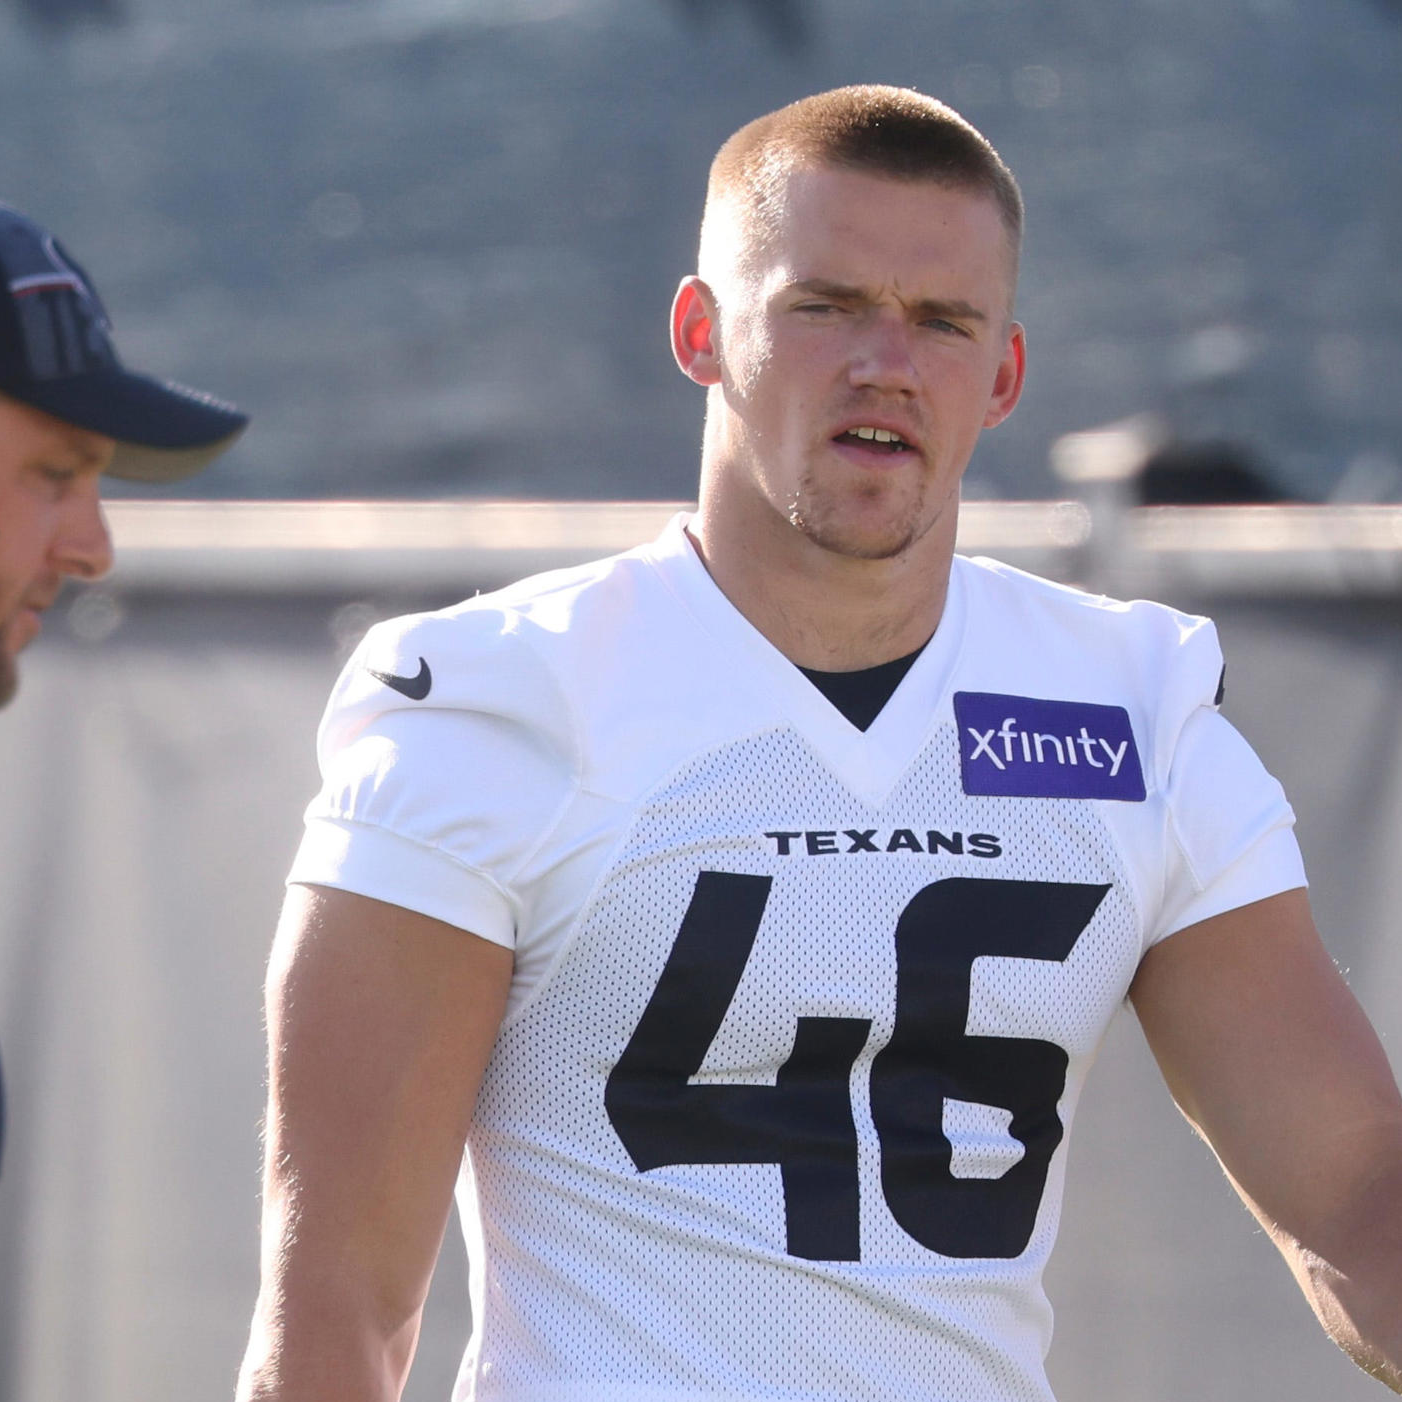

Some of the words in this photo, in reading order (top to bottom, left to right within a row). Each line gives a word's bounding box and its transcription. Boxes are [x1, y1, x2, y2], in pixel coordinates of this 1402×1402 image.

[967, 718, 1128, 777] xfinity
[763, 828, 1003, 859] TEXANS
[603, 869, 1114, 1263] 46
